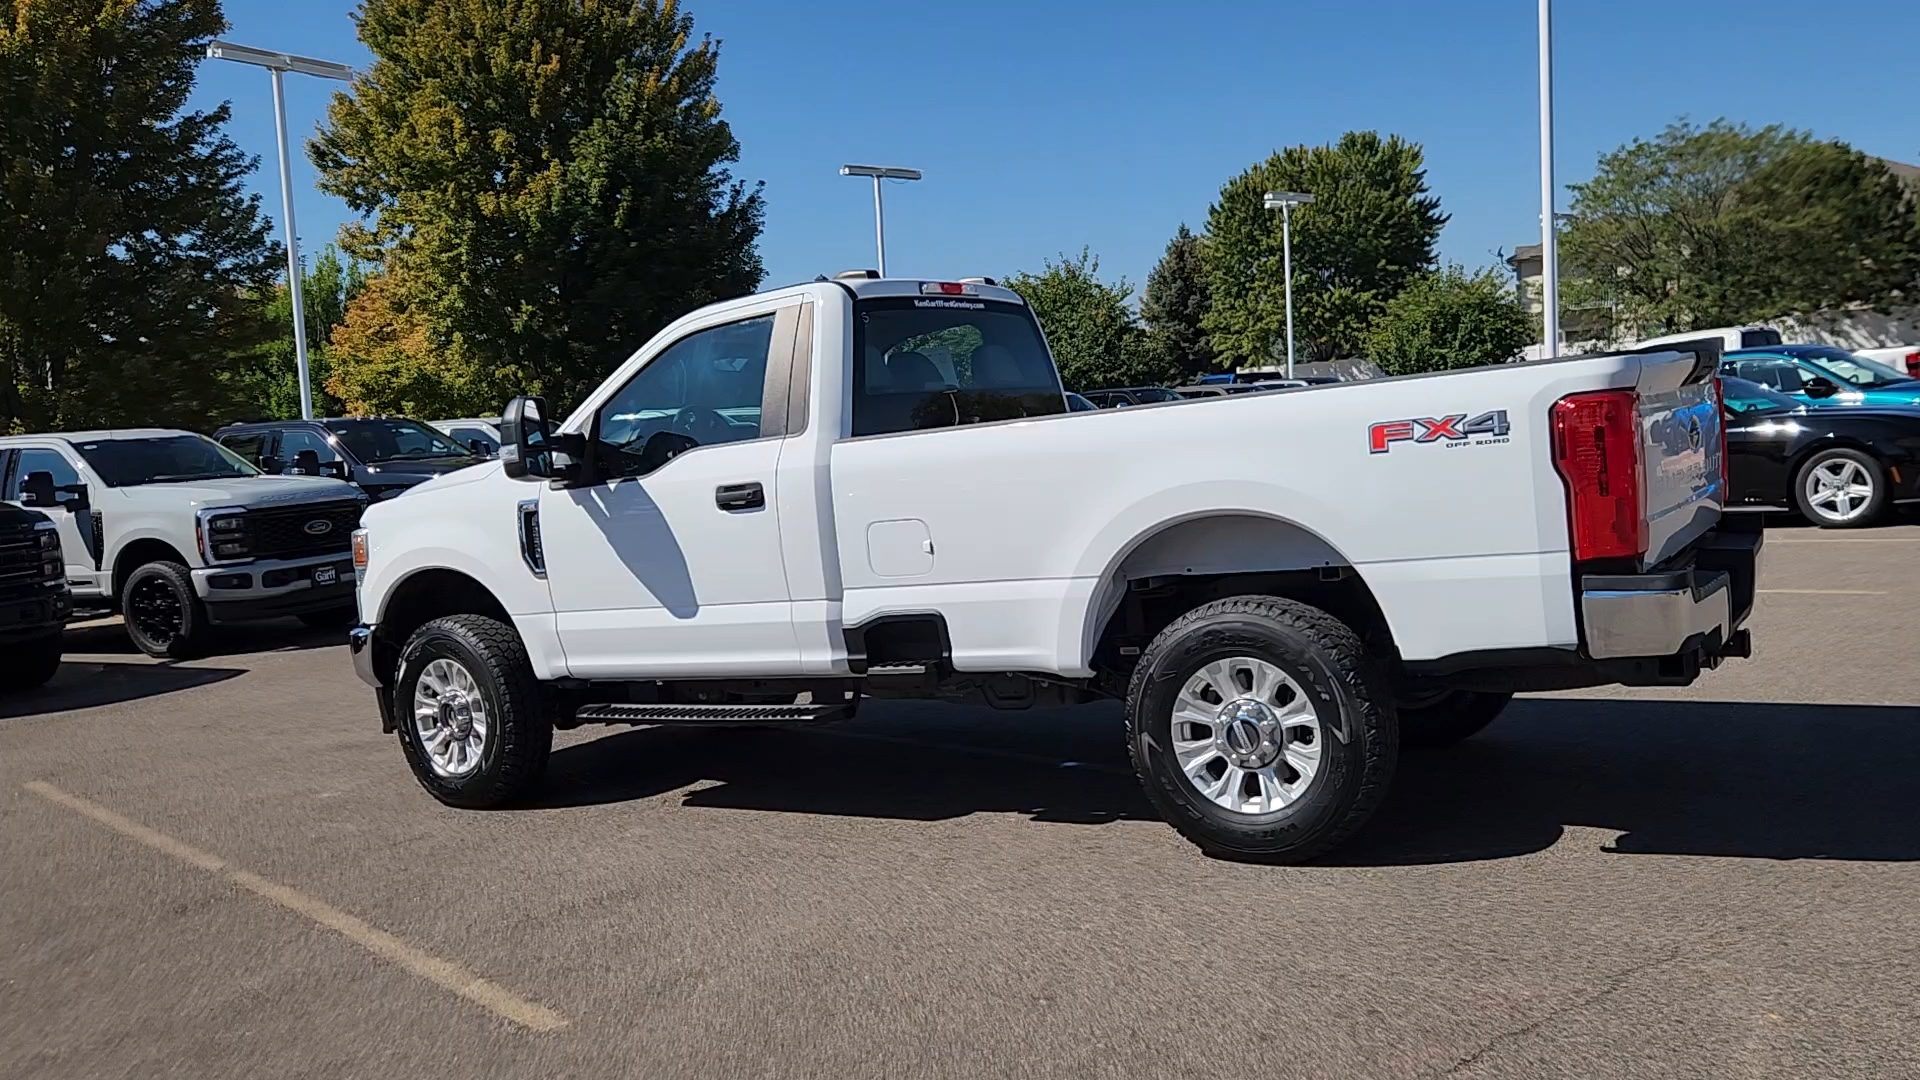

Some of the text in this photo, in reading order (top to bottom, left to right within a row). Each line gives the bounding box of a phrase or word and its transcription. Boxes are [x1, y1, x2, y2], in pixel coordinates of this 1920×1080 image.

[1368, 409, 1511, 455] FX4
[1446, 437, 1510, 449] OFF ROAD
